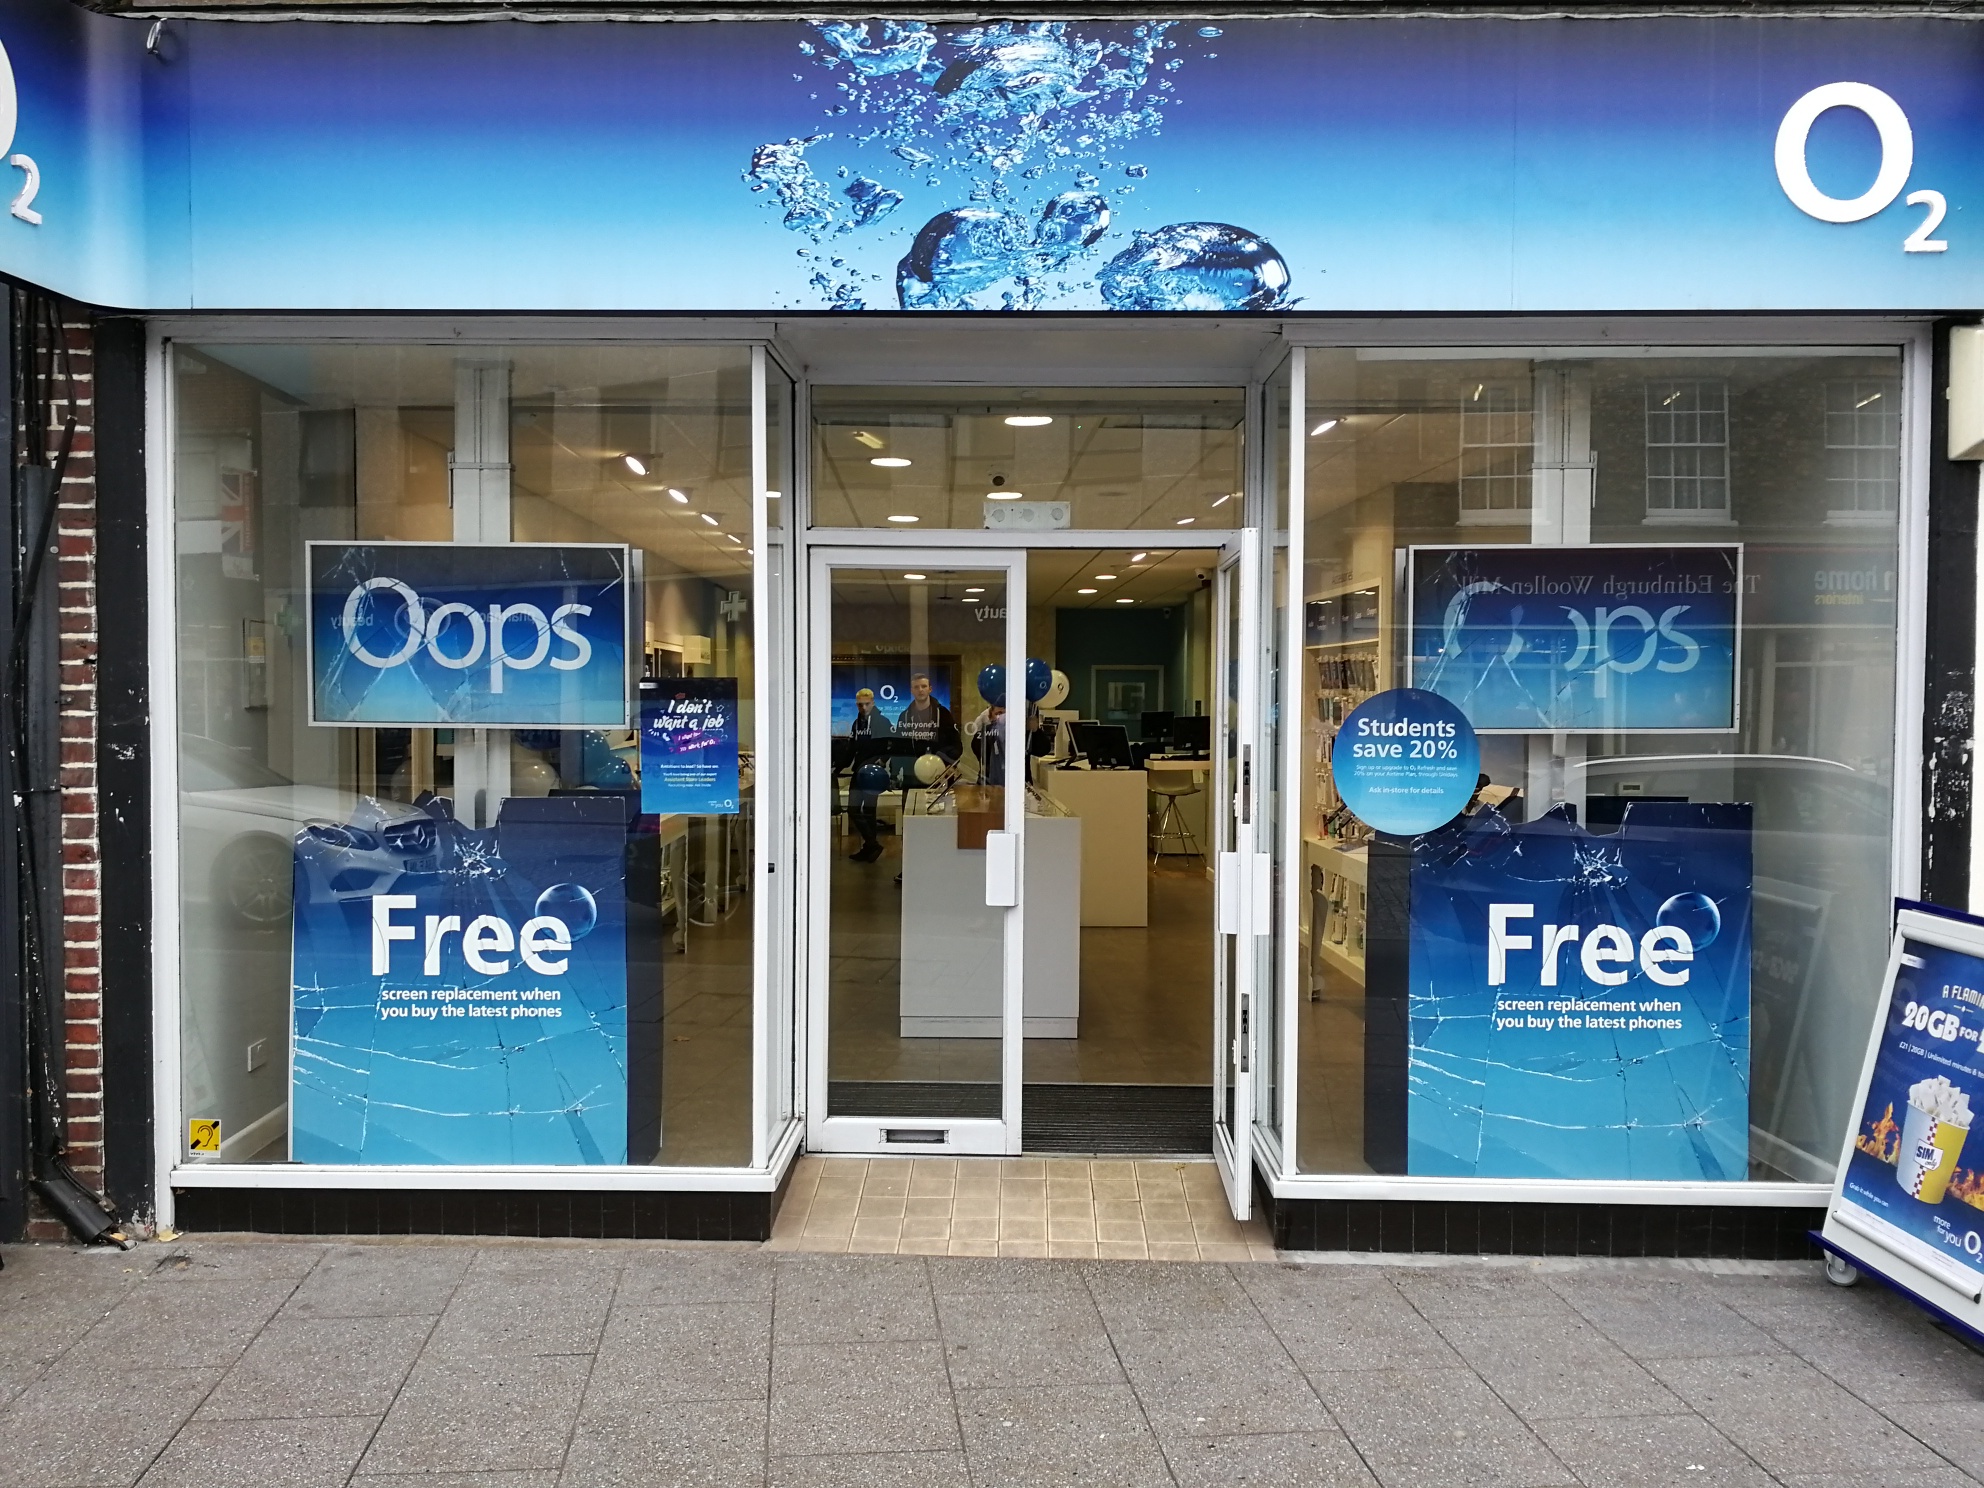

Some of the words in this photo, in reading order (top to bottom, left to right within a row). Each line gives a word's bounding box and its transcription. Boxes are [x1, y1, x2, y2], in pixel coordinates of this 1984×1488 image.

[1774, 81, 1948, 252] O2
[342, 576, 593, 694] Oops
[880, 684, 899, 703] O2
[676, 699, 713, 713] don't
[653, 715, 688, 731] want
[702, 713, 725, 731] job
[1357, 717, 1456, 737] Students
[1352, 742, 1403, 759] save
[1409, 740, 1458, 759] 20%
[371, 894, 573, 977] Free
[1488, 903, 1695, 987] Free
[381, 988, 428, 1001] screen
[431, 988, 518, 1004] replacement
[520, 988, 561, 1001] when
[1942, 984, 1950, 999] A
[380, 1007, 408, 1020] you
[411, 1003, 438, 1020] buy
[441, 1004, 465, 1018] the
[468, 1003, 509, 1018] latest
[510, 1004, 562, 1020] phones
[1497, 998, 1544, 1011] screen
[1547, 997, 1636, 1014] replacement
[1639, 998, 1682, 1012] when
[1496, 1016, 1525, 1030] you
[1527, 1013, 1553, 1030] buy
[1557, 1014, 1582, 1028] the
[1585, 1014, 1627, 1029] latest
[1628, 1015, 1683, 1031] phones
[1902, 1001, 1960, 1042] 20GB
[1959, 1026, 1979, 1042] FOR
[1916, 1145, 1935, 1161] SIM
[1933, 1215, 1951, 1230] more
[1943, 1232, 1962, 1248] you
[1964, 1231, 1983, 1264] O2
